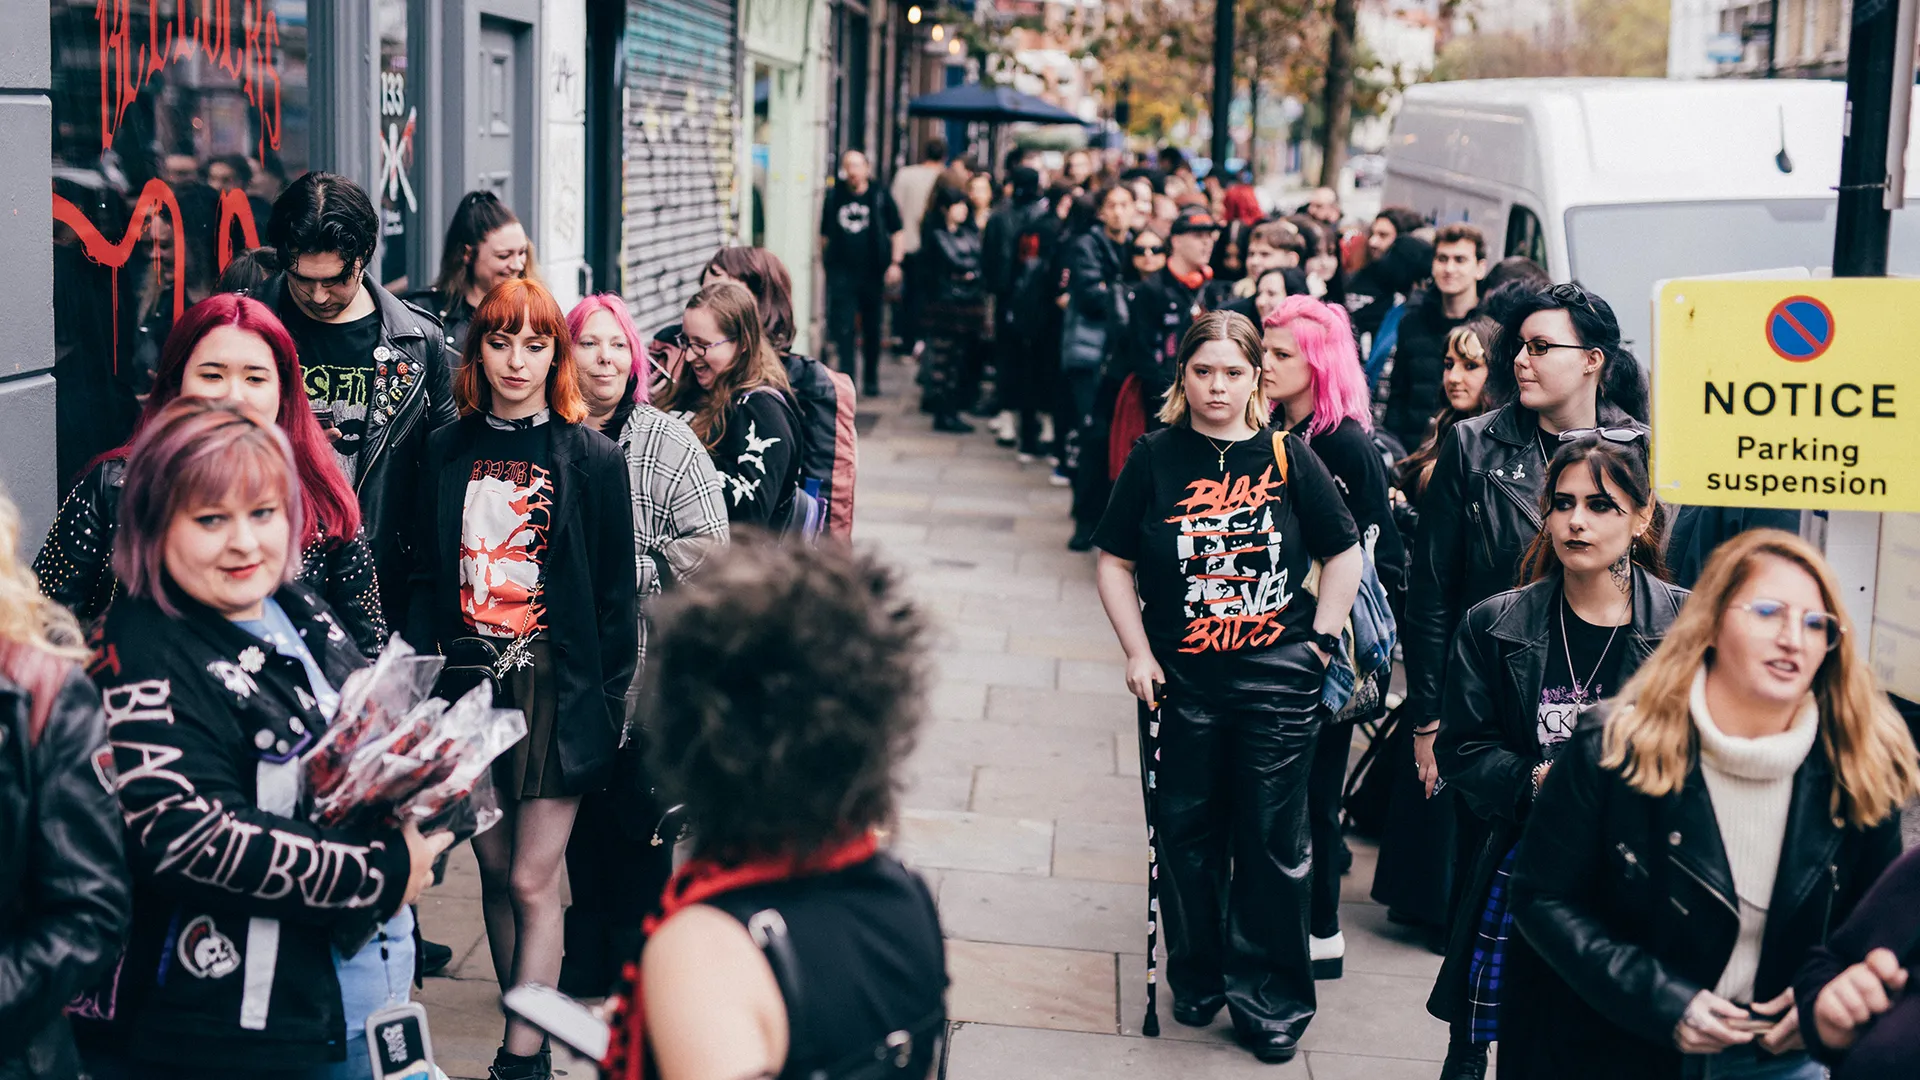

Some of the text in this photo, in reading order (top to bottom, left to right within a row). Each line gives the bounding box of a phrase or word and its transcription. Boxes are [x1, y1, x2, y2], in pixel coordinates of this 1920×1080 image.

[381, 72, 405, 116] 133
[298, 364, 375, 407] SFIT
[1704, 381, 1897, 418] NOTICE
[1737, 435, 1859, 467] Parking
[1163, 464, 1285, 524] BLACK
[1706, 471, 1887, 496] suspension
[1537, 710, 1574, 734] ACK
[102, 679, 210, 848] BLACK
[154, 799, 263, 893] VEIL
